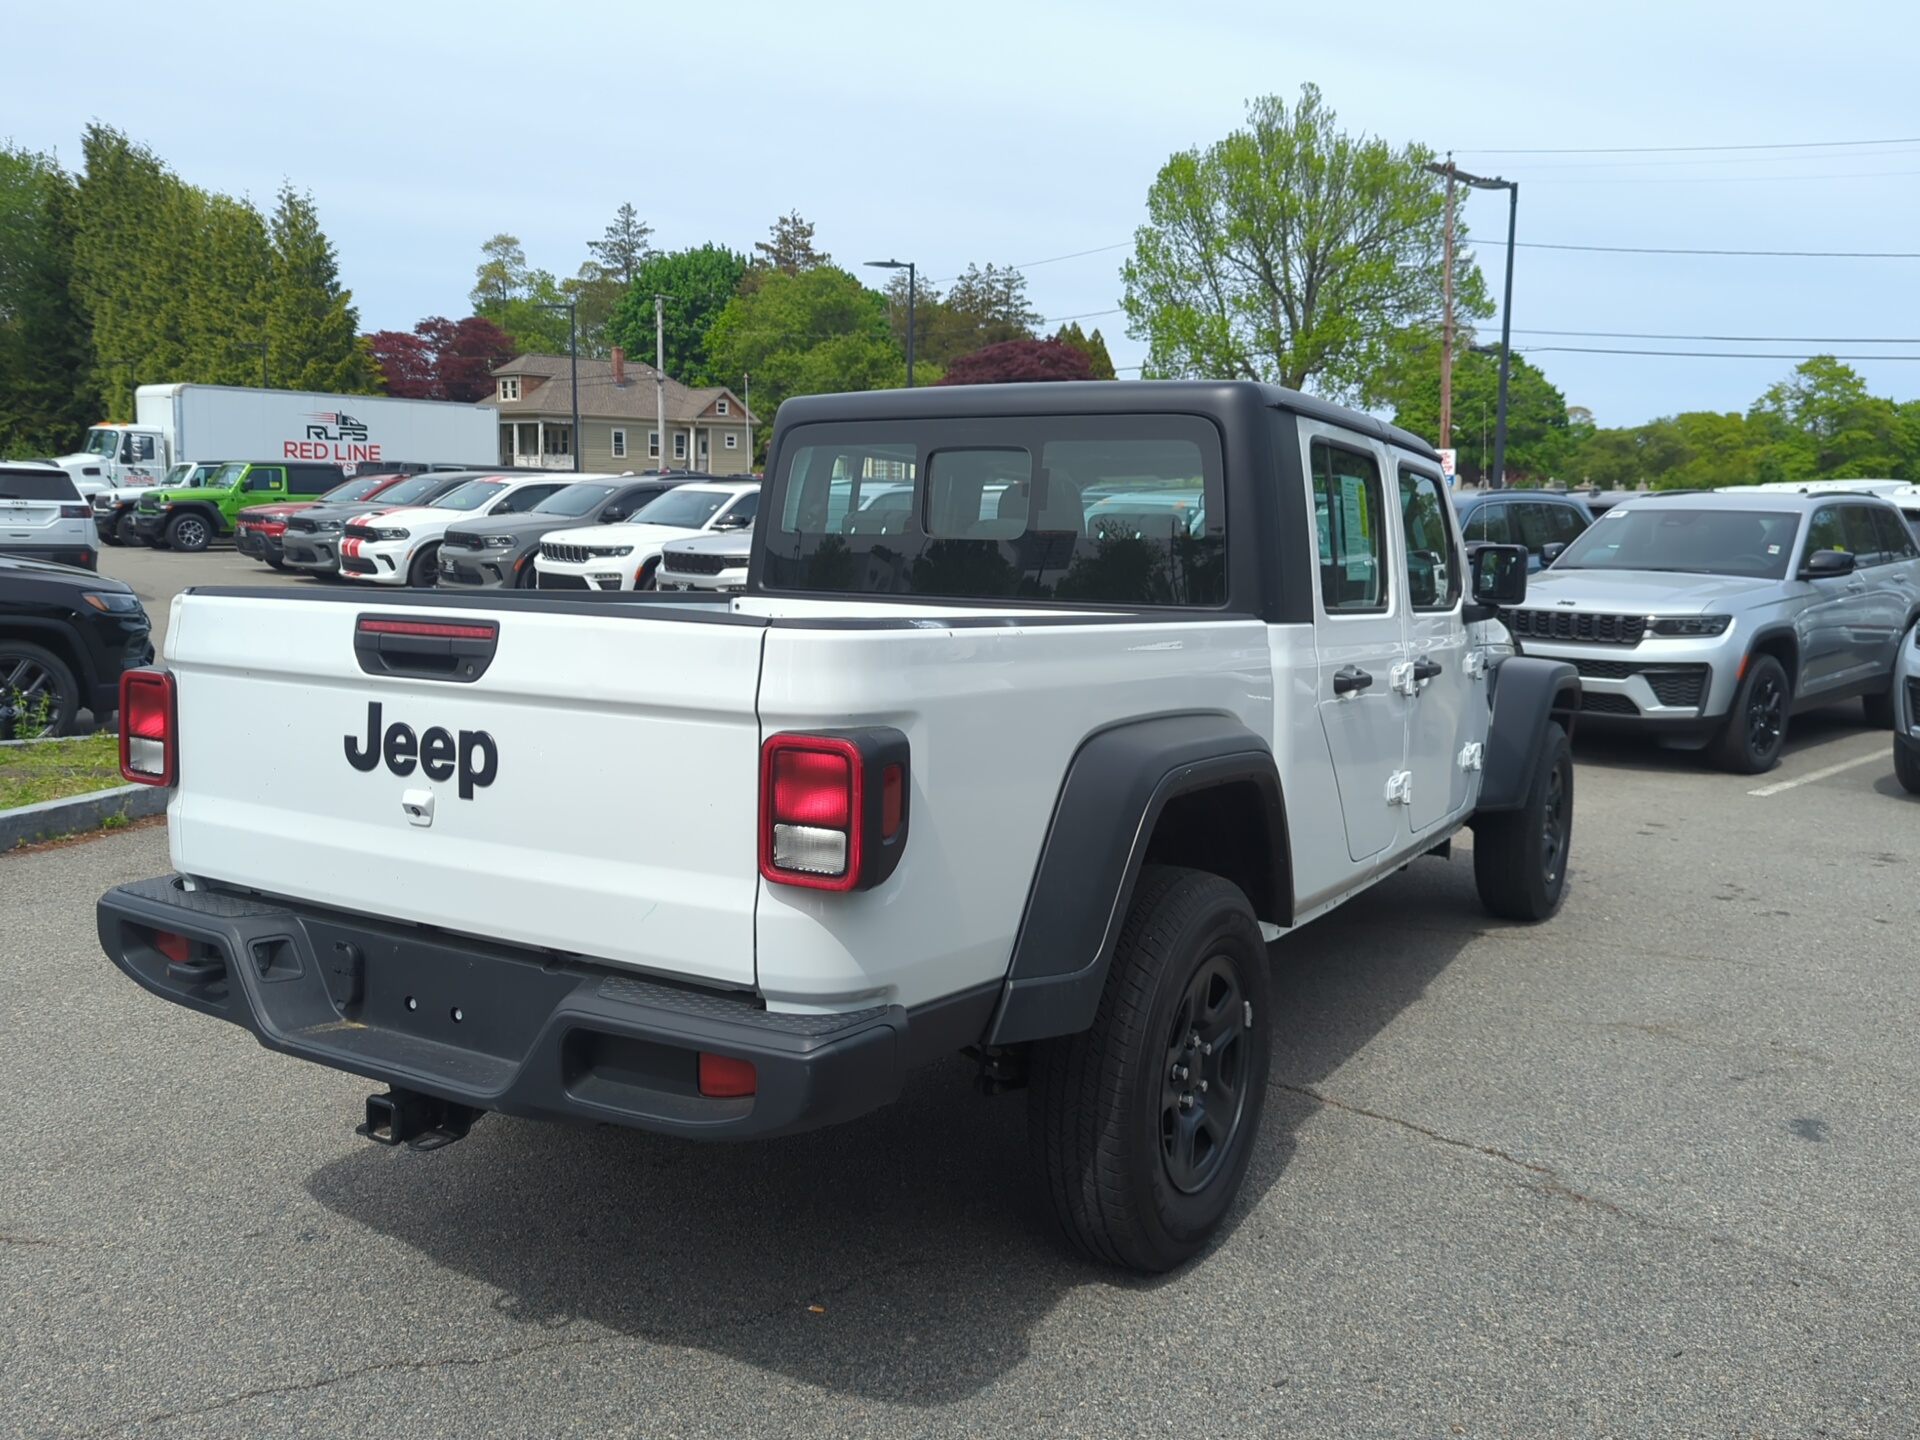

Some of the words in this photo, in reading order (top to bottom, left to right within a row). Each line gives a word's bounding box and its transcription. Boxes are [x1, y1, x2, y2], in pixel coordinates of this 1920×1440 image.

[307, 425, 368, 441] RLFS
[283, 441, 329, 460] RED
[335, 443, 381, 462] LINE
[344, 701, 498, 801] Jeep
